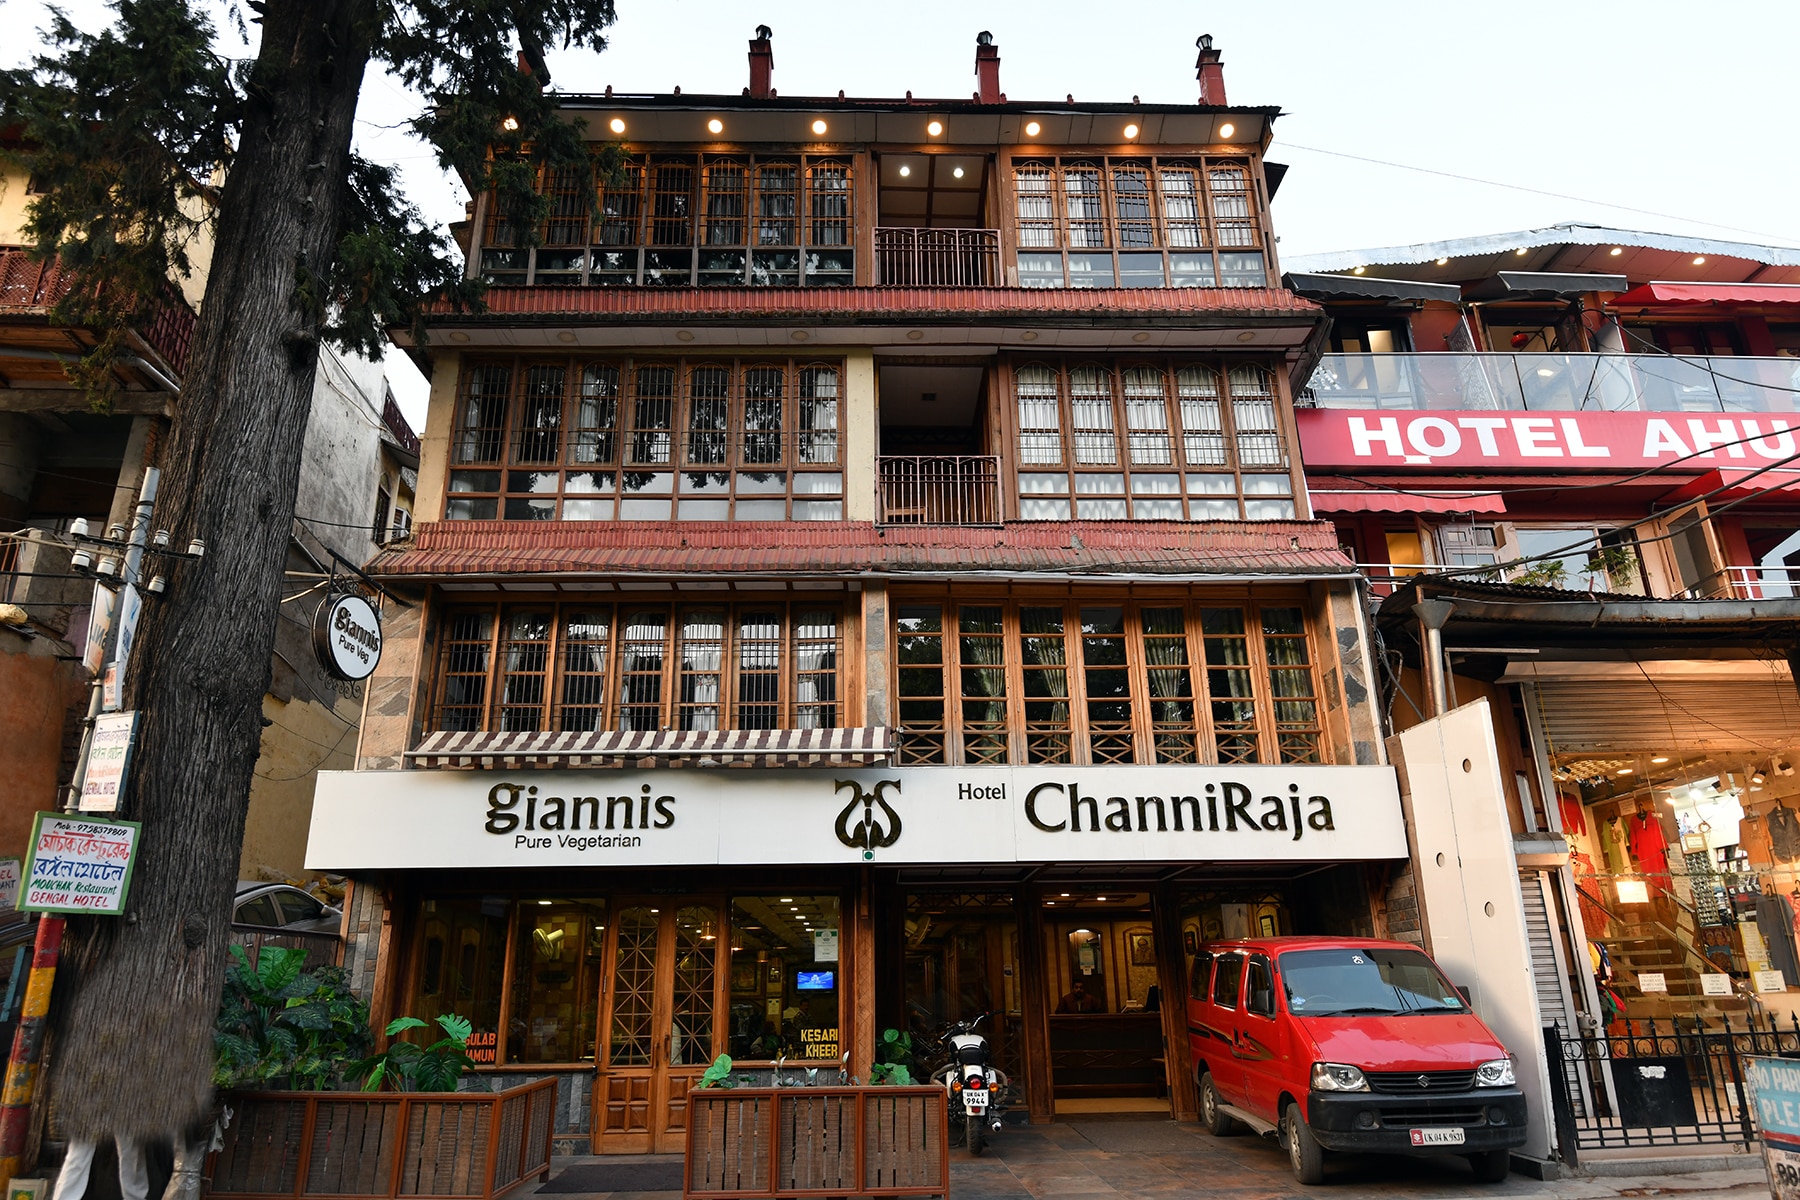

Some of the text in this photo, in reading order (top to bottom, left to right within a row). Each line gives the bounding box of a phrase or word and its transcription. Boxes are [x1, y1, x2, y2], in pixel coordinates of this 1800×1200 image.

[1347, 416, 1796, 459] HOTEL AHU
[335, 606, 380, 652] giannis
[338, 634, 369, 664] Pure Veg
[485, 782, 676, 835] giannis
[958, 782, 1335, 841] Hotel ChanniRaja
[515, 834, 641, 851] Pure Vegetarian
[30, 891, 109, 907] BENGAL HOTEL
[801, 1029, 838, 1042] KESARI
[806, 1044, 838, 1057] KHEER
[1771, 1066, 1800, 1093] PAR
[1761, 1098, 1800, 1128] PLE
